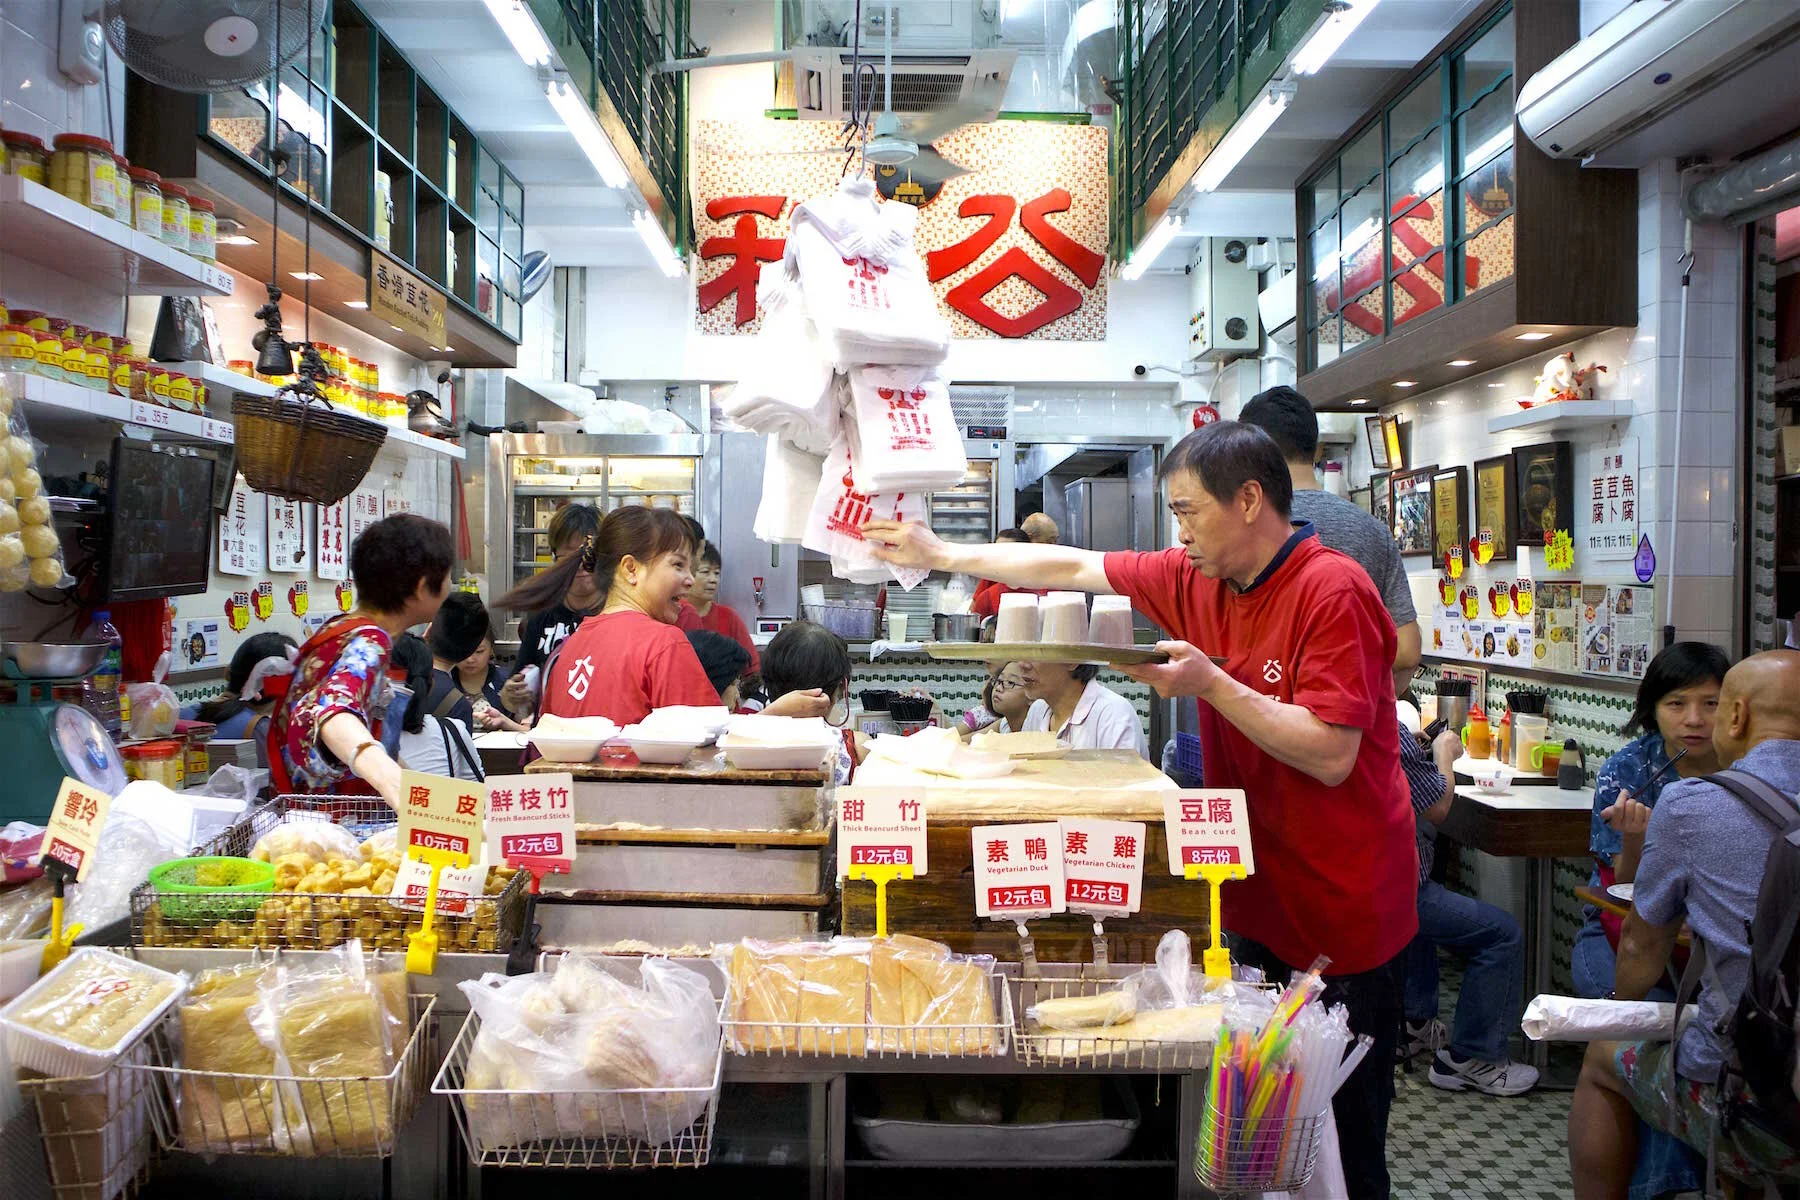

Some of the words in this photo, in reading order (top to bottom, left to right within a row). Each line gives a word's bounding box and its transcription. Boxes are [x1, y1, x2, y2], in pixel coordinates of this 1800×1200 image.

[152, 409, 168, 425] 35元
[1589, 537, 1601, 549] 11元
[1604, 535, 1616, 548] 11元
[1618, 534, 1631, 547] 11元
[408, 786, 477, 816] 腐皮
[491, 787, 569, 812] 鮮枝竹
[491, 815, 511, 823] Fresh
[513, 813, 548, 822] Beancurd
[549, 812, 570, 820] Sticks
[842, 799, 921, 822] 甜竹
[1180, 798, 1232, 824] 豆腐
[1213, 827, 1236, 836] curd
[415, 833, 464, 853] 10元包
[506, 836, 559, 853] 12元包
[986, 837, 1047, 862] 素鴨
[1065, 831, 1137, 858] 素雞
[856, 848, 908, 865] 12元包
[1064, 857, 1104, 868] Vegetarian
[1106, 861, 1136, 870] Chicken
[1191, 848, 1231, 864] 8元份
[987, 865, 1028, 874] Vegetarian
[1030, 863, 1049, 872] Duck
[447, 873, 472, 882] Puff
[992, 888, 1046, 907] 12元包
[1070, 883, 1123, 903] 12元包
